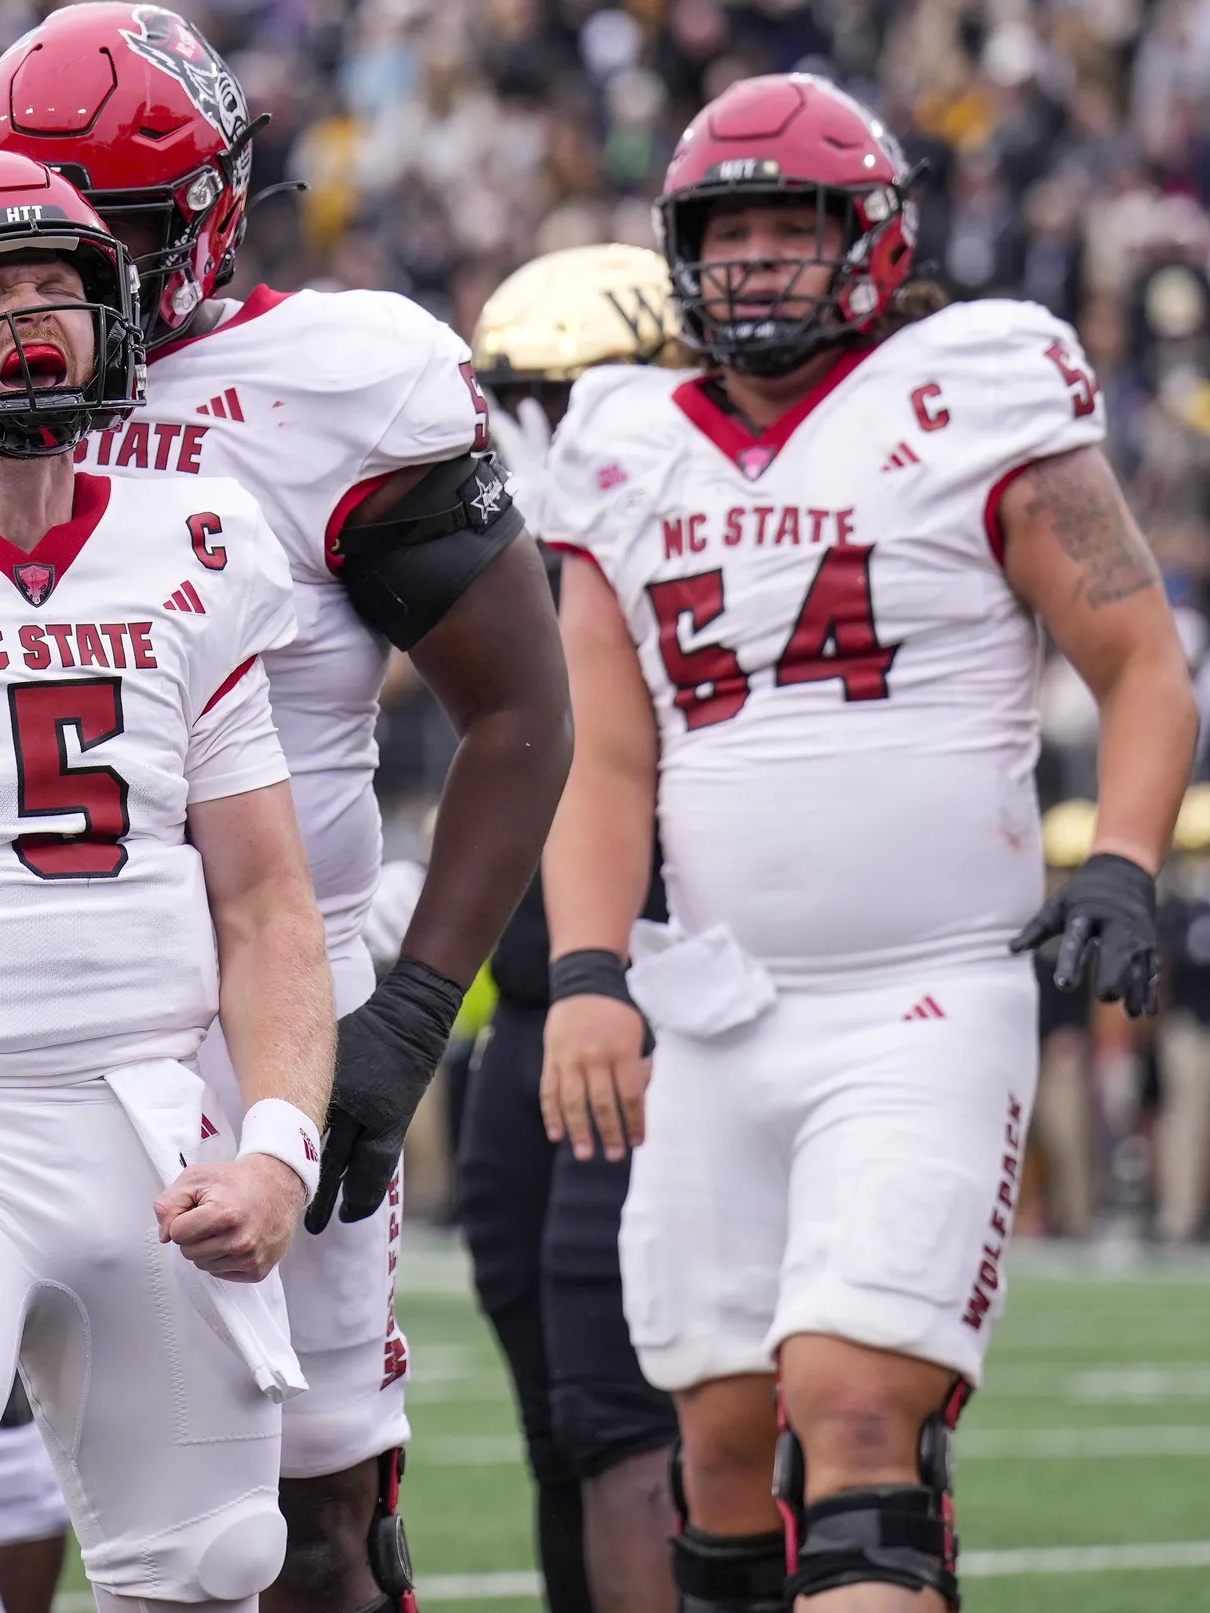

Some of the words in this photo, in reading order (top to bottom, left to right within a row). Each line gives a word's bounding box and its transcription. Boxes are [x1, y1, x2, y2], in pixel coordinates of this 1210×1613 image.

[6, 205, 43, 223] HTT
[911, 383, 950, 432] C
[186, 511, 227, 571] C
[663, 510, 707, 560] NC
[724, 506, 855, 548] STATE
[18, 622, 158, 670] STATE
[645, 543, 901, 732] 54
[7, 676, 130, 881] 5
[961, 1092, 1022, 1332] WOLFPACK
